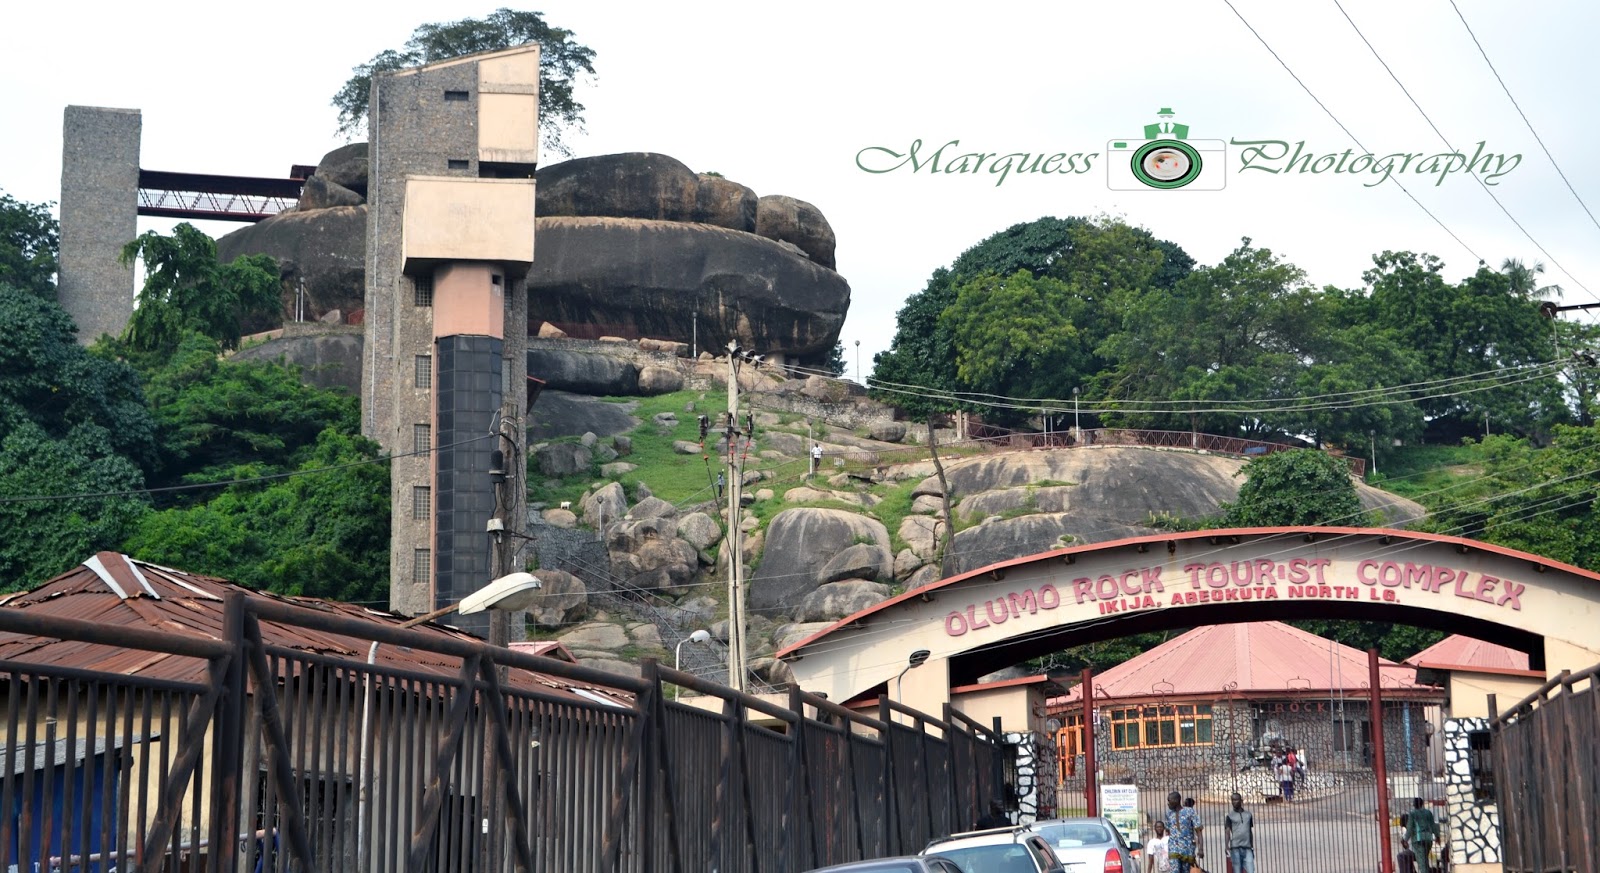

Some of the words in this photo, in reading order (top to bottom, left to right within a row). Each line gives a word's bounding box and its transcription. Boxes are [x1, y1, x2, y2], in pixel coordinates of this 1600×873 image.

[944, 584, 1060, 637] OLUMO
[1072, 566, 1165, 605] ROCK
[1184, 558, 1331, 590] TOURIST
[1356, 559, 1526, 612] COMPLEX
[1098, 594, 1162, 616] IKIJA,
[1170, 586, 1279, 606] ABEOKUTA
[1287, 586, 1359, 600] NORTH
[1274, 702, 1327, 714] ROCK
